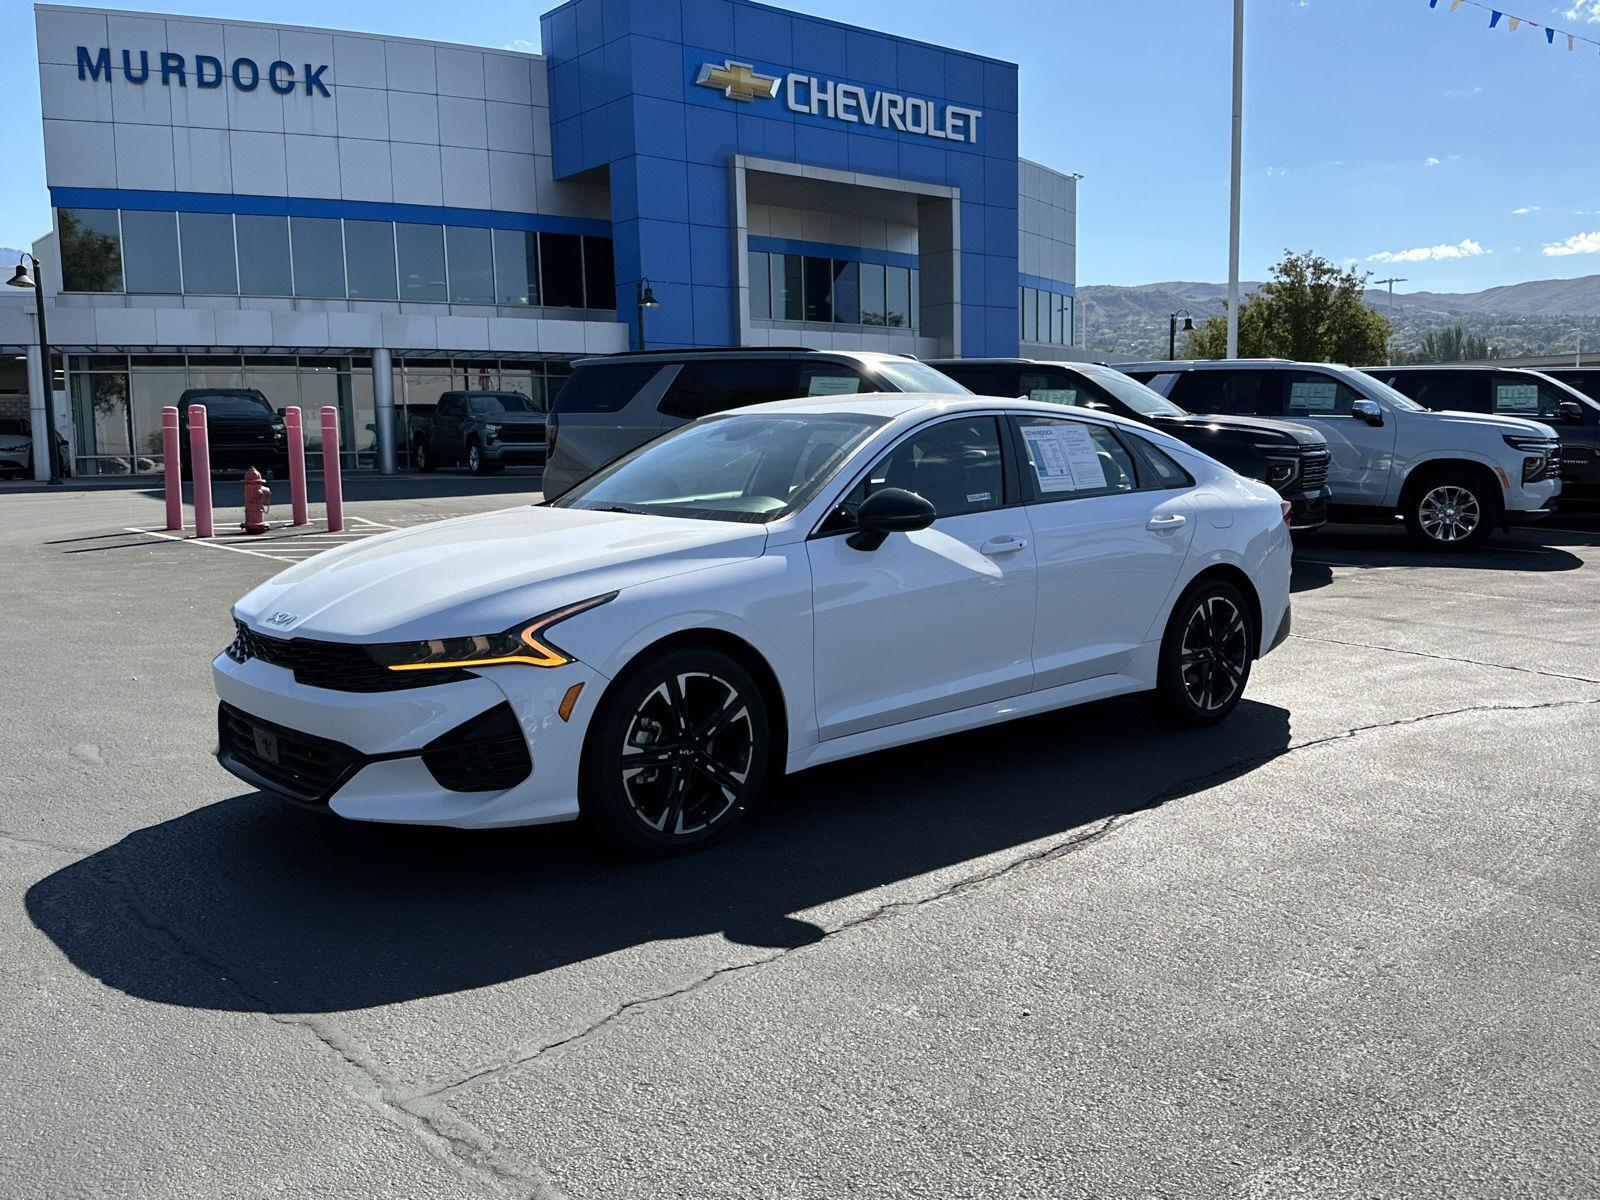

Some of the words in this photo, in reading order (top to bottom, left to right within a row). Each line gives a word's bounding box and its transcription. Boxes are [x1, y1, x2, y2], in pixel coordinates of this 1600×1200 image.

[76, 46, 332, 98] MURDOCK
[786, 72, 983, 144] CHEVROLET
[266, 611, 298, 626] KIA
